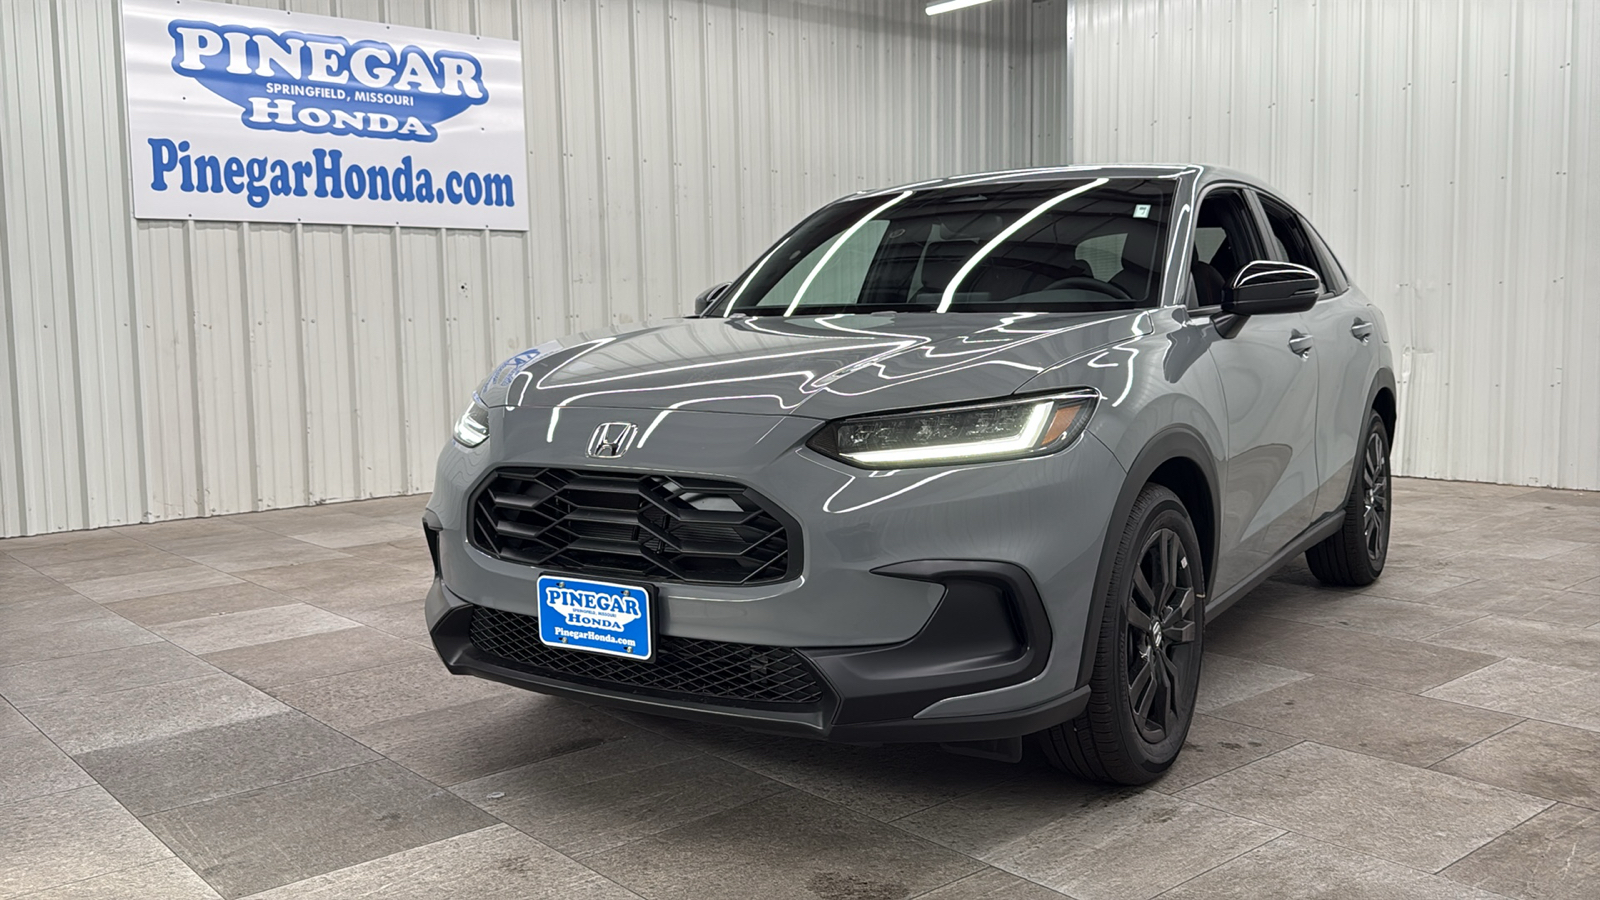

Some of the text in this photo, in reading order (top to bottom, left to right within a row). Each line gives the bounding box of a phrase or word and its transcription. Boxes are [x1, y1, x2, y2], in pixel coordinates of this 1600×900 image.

[176, 26, 484, 99] PINEGAR
[266, 82, 414, 106] SPRINGFIELD, MISSOURI
[147, 137, 515, 208] PinegarHonda.com
[548, 590, 639, 616] PINEGAR
[554, 626, 636, 647] PinegarHonda.com
